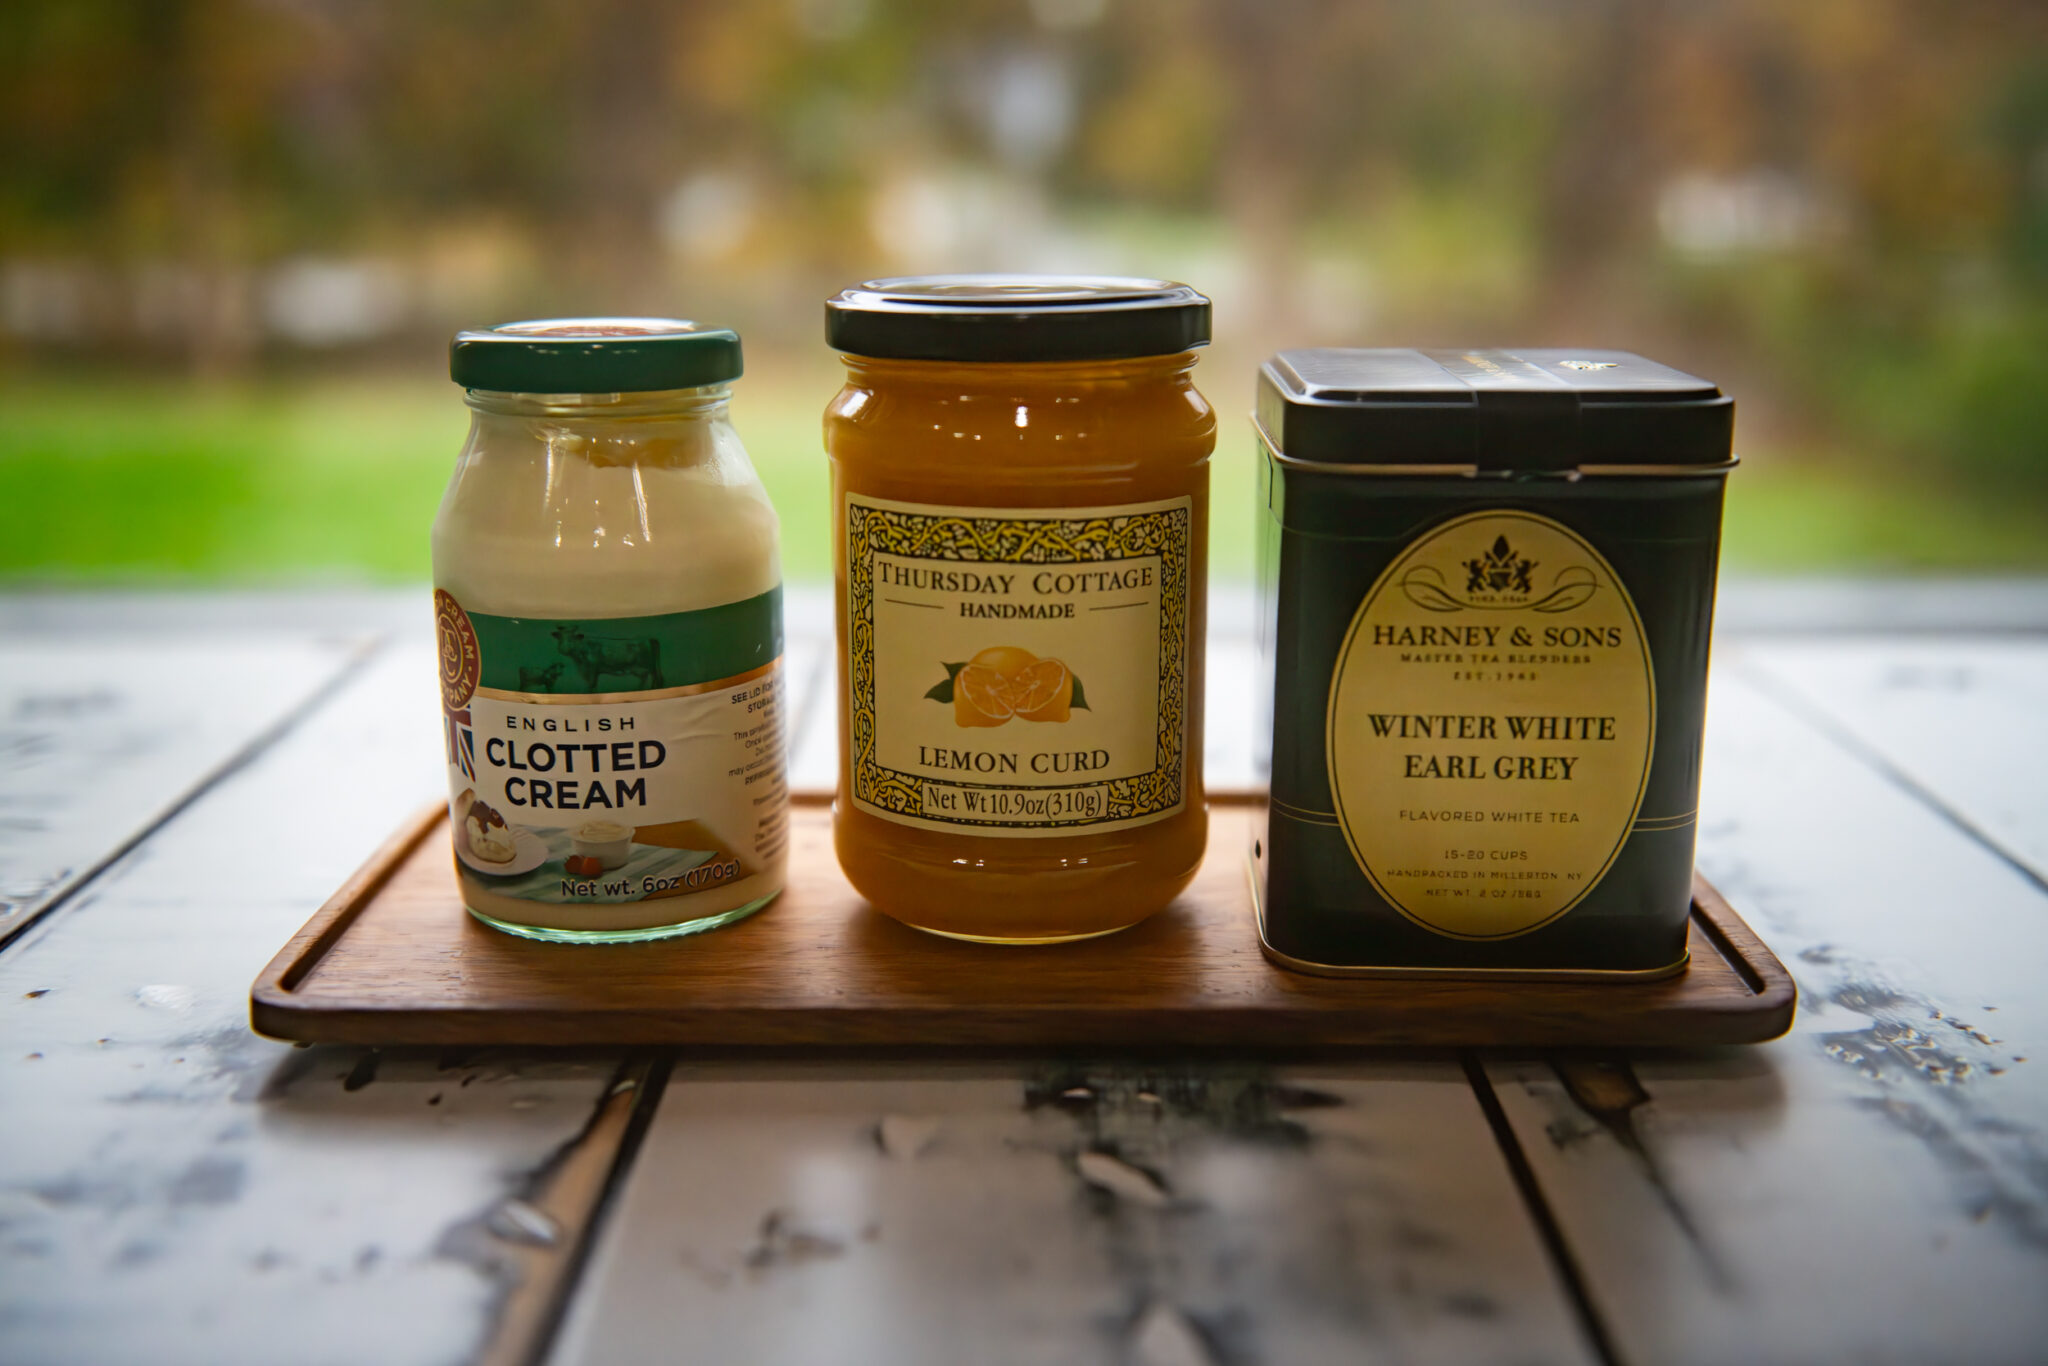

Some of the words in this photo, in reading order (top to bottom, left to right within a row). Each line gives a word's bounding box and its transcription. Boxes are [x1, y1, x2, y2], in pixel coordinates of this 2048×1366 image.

[879, 561, 1016, 594] THURSDAY
[1032, 567, 1153, 594] COTTAGE
[960, 602, 1075, 619] HANDMADE
[1373, 625, 1500, 647] HARNEY
[1510, 626, 1533, 647] &
[1544, 626, 1622, 648] SONS
[506, 716, 635, 732] ENGLISH
[1368, 714, 1498, 740] WINTER
[1505, 715, 1616, 741] WHITE
[486, 737, 666, 774] CLOTTED
[919, 745, 1018, 773] LEMON
[1030, 749, 1110, 773] CURD
[1404, 754, 1486, 779] EARL
[1494, 756, 1579, 780] GREY
[505, 777, 647, 810] CREAM
[928, 786, 957, 810] Net
[963, 791, 988, 813] Wt
[1399, 809, 1485, 822] FLAVORED
[1491, 811, 1543, 823] WHITE
[1550, 812, 1580, 823] TEA
[1490, 850, 1528, 861] CUPS
[561, 879, 597, 897] Net
[604, 879, 635, 896] wt.
[642, 876, 680, 894] 6oz
[685, 859, 741, 888] (170g)
